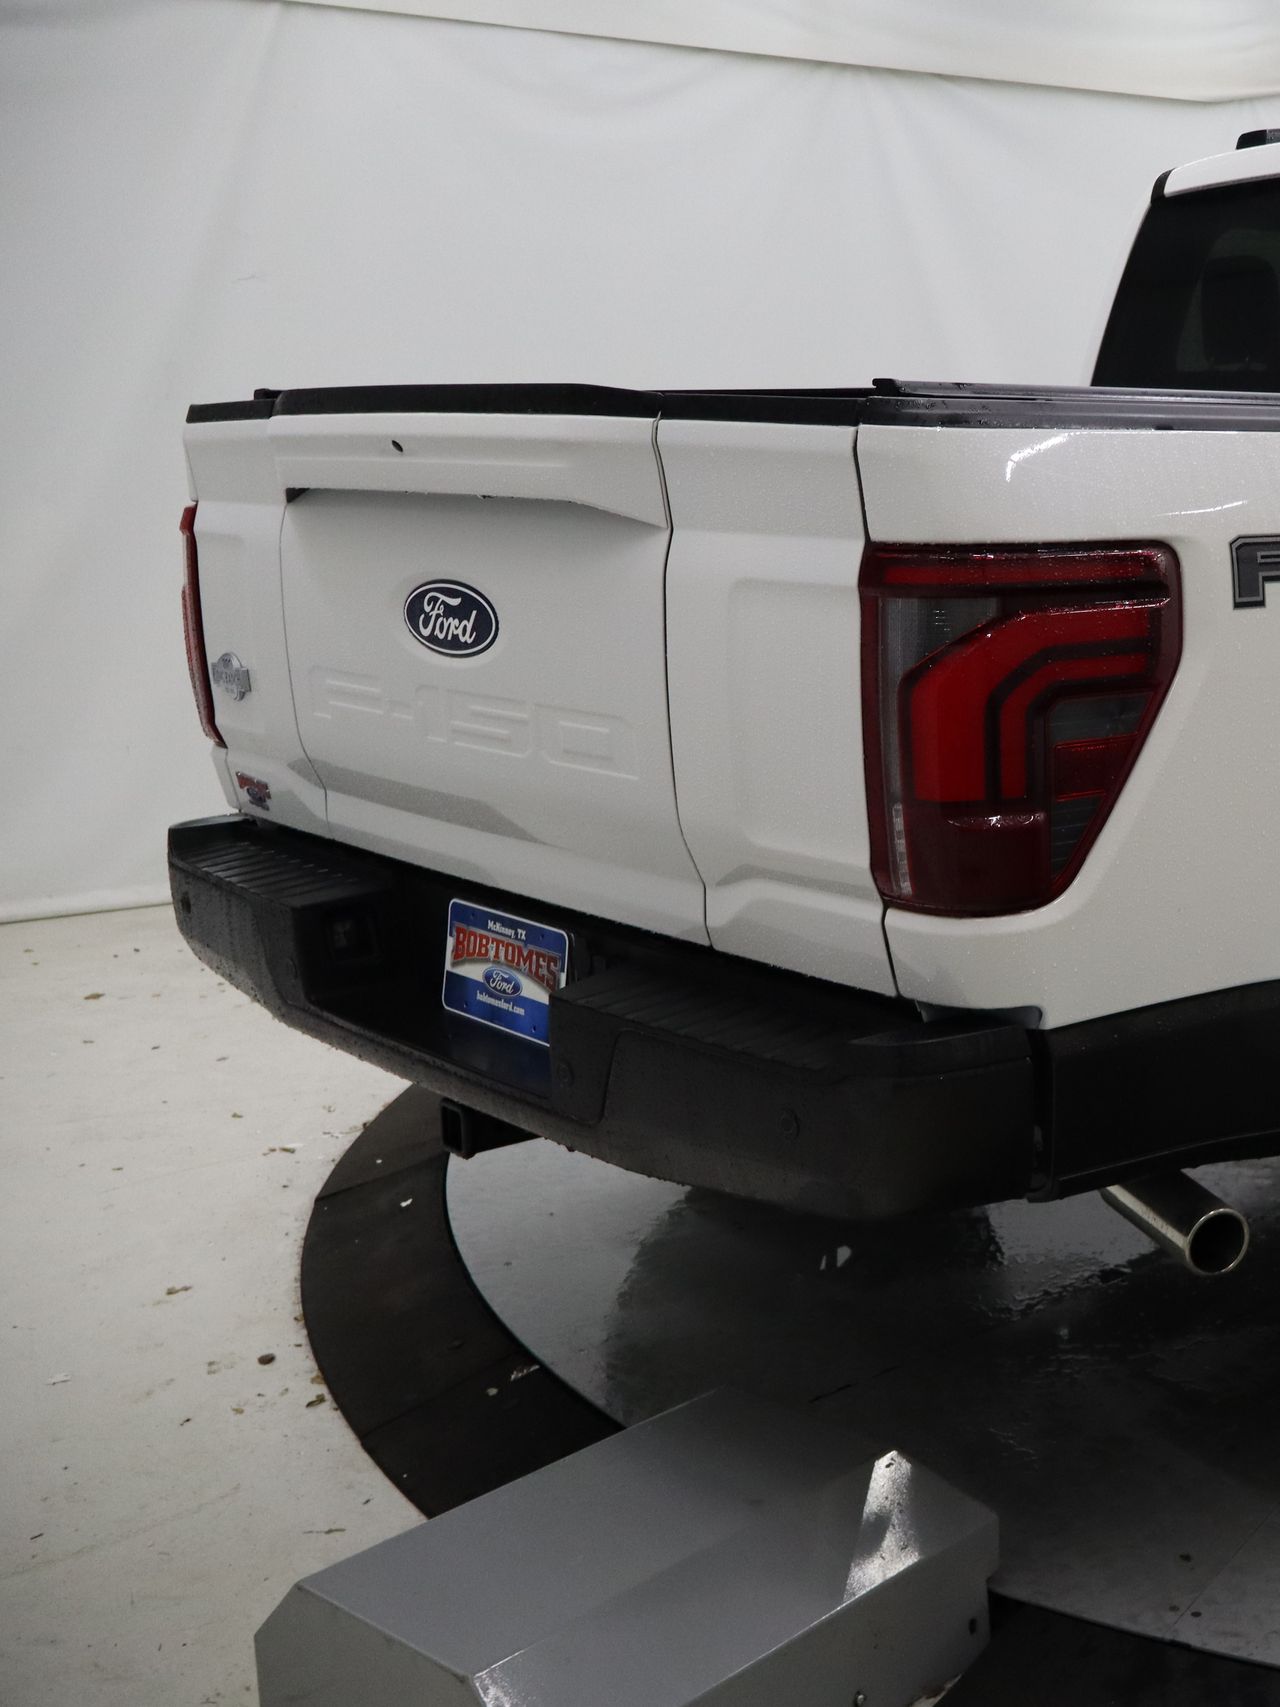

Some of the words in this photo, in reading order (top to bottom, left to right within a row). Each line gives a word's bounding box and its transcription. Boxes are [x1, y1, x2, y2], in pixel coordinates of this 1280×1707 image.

[418, 591, 478, 645] Ford
[307, 664, 640, 782] F-150
[517, 928, 527, 941] TX
[489, 970, 516, 994] Ford
